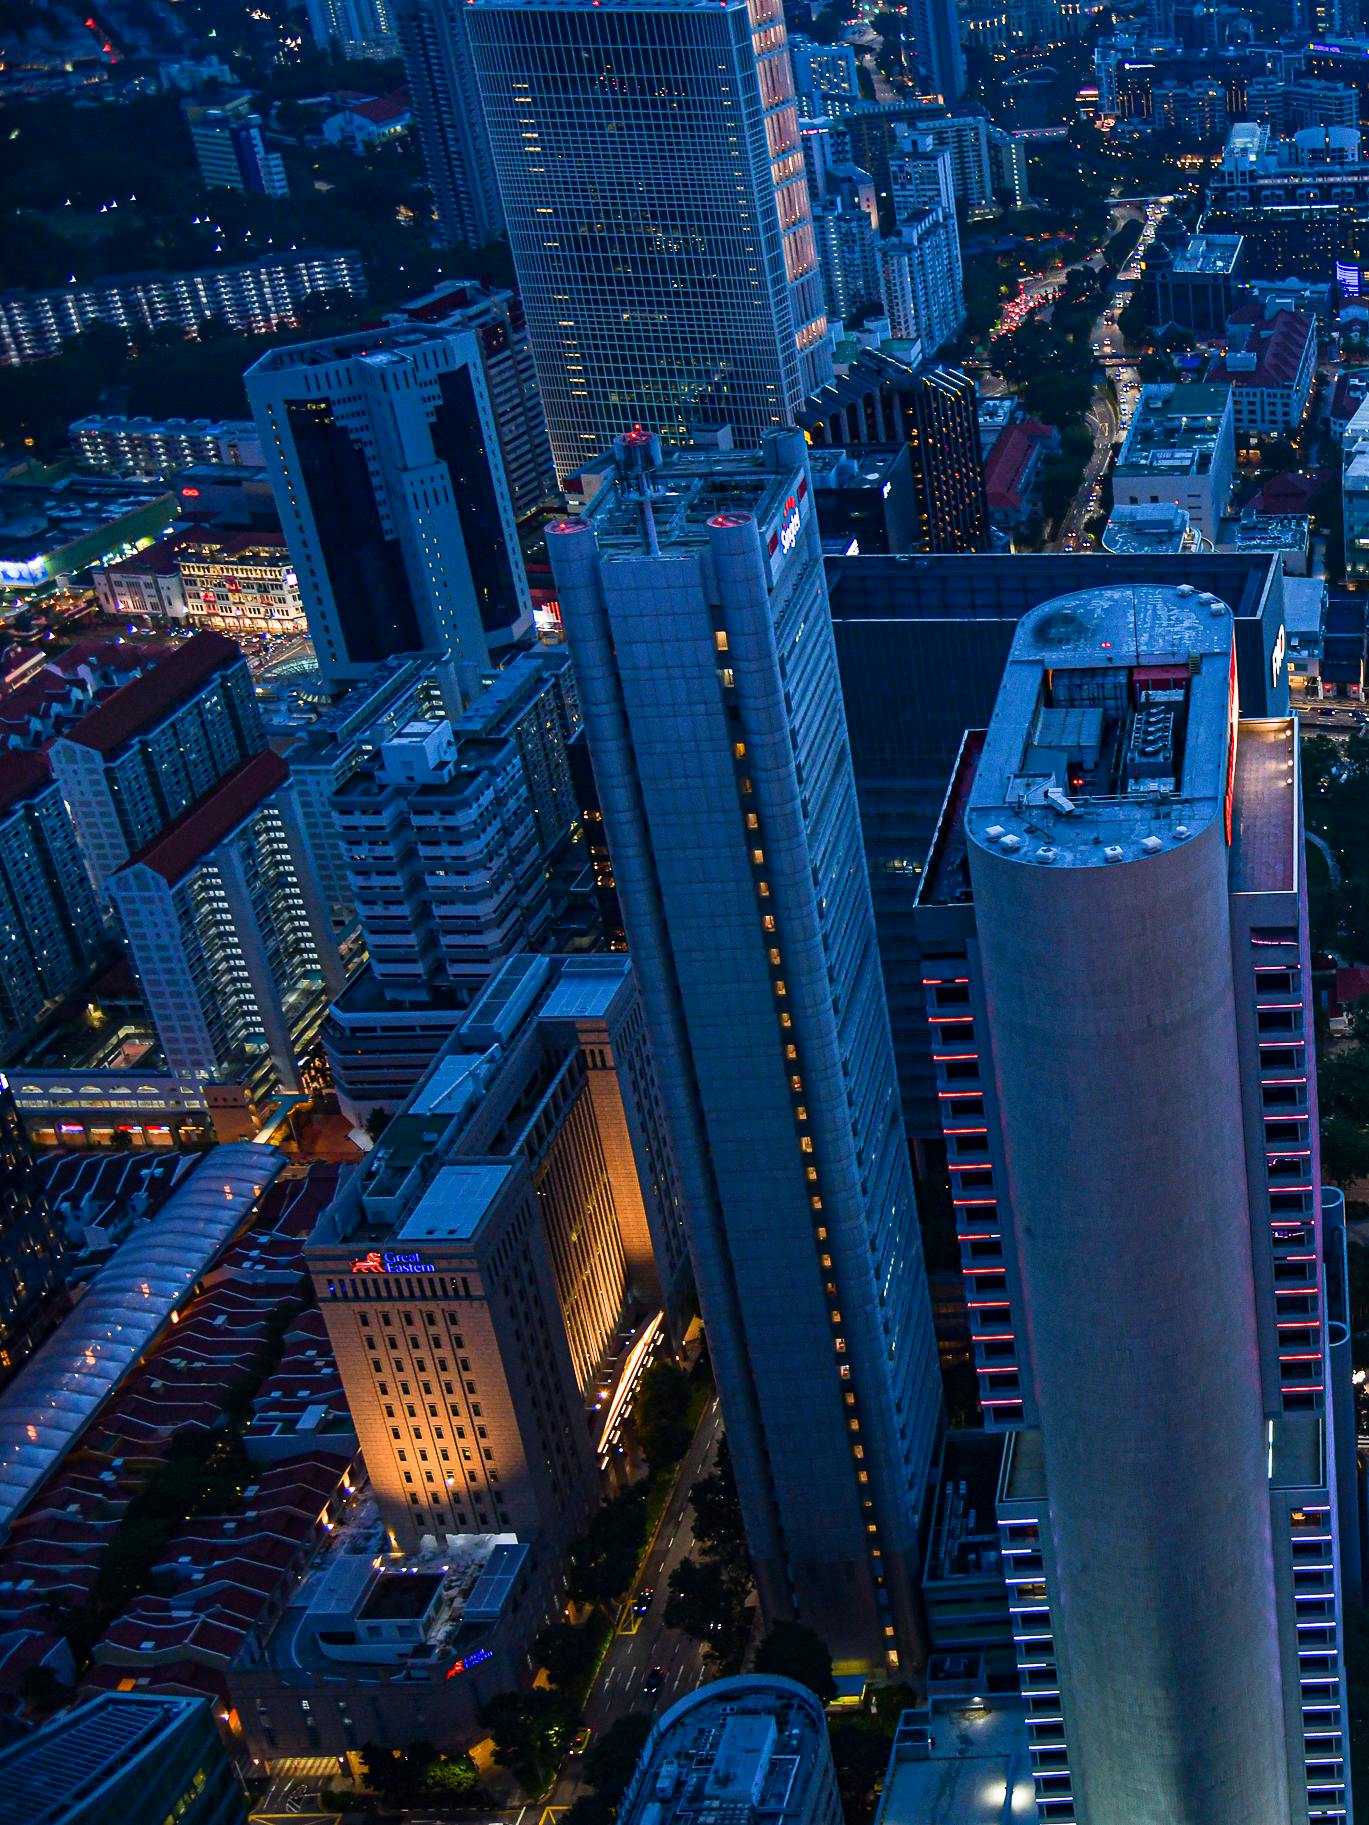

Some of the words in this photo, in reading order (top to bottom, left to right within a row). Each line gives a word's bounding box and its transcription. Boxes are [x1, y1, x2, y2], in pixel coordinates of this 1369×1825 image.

[780, 507, 801, 554] Singtel
[384, 1251, 420, 1262] Great
[386, 1262, 435, 1273] Eastern
